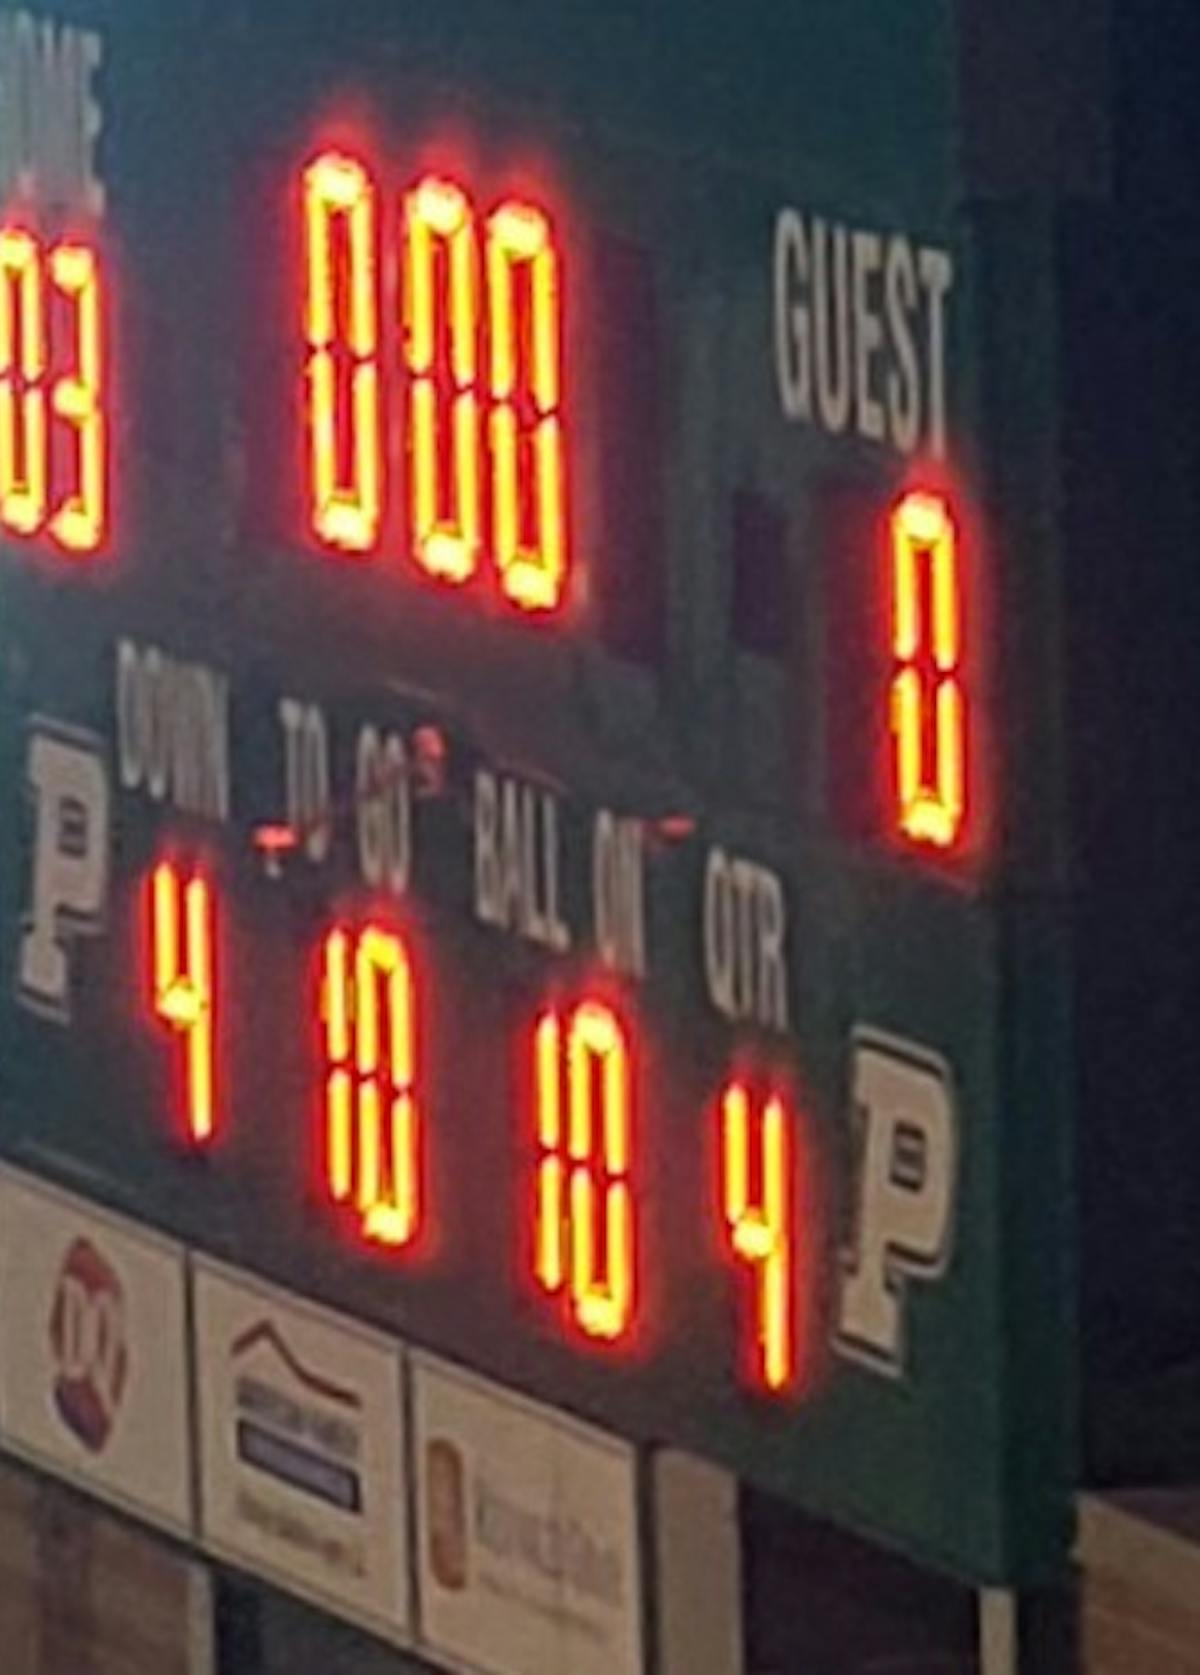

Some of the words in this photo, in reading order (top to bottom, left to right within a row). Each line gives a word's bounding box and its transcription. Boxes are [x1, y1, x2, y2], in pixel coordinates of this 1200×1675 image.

[774, 206, 953, 460] GUEST
[117, 640, 230, 822] DOWN
[280, 698, 329, 864] TO
[358, 723, 412, 894] GO
[890, 490, 962, 848] 0
[146, 860, 215, 1142] 4
[474, 770, 571, 954] BALL
[704, 846, 790, 1032] QTR
[326, 925, 415, 1245] 10
[535, 1000, 632, 1342] 10
[723, 1078, 791, 1390] 4
